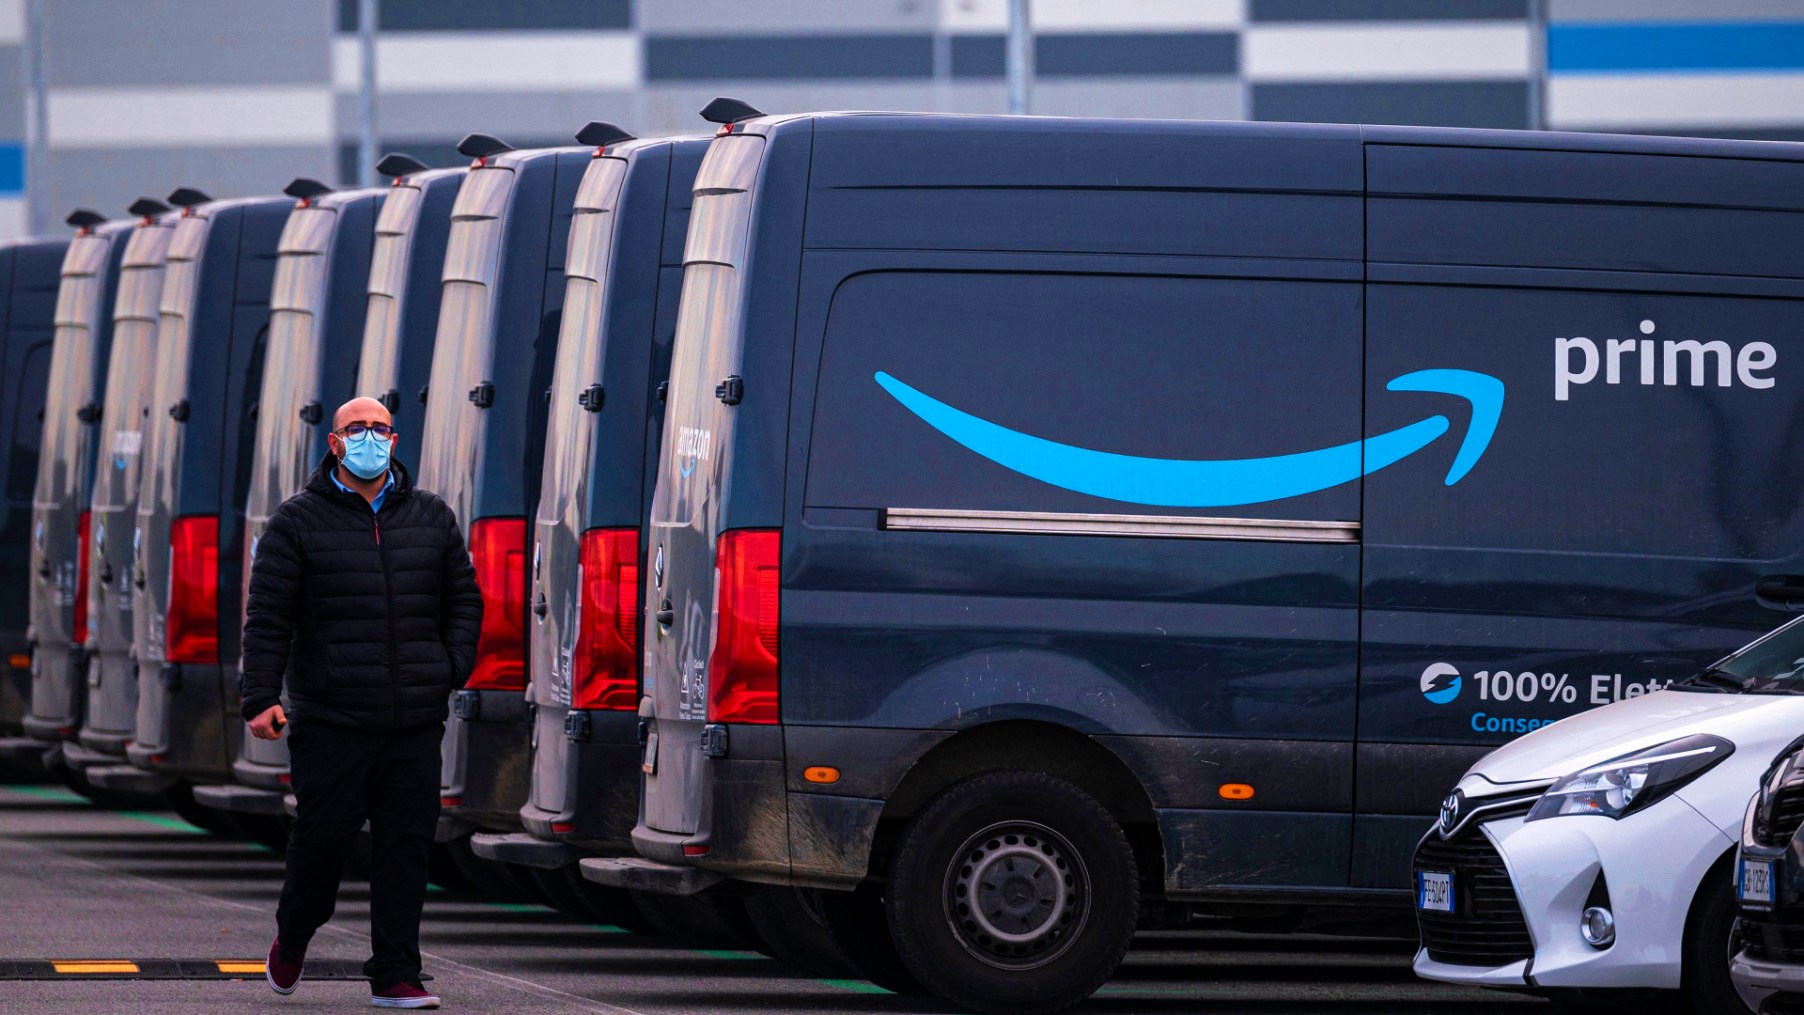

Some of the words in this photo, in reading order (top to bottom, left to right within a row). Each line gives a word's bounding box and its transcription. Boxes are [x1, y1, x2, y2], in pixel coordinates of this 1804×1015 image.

[1555, 319, 1777, 401] prime
[677, 425, 711, 460] amazon
[1473, 670, 1577, 703] 100%
